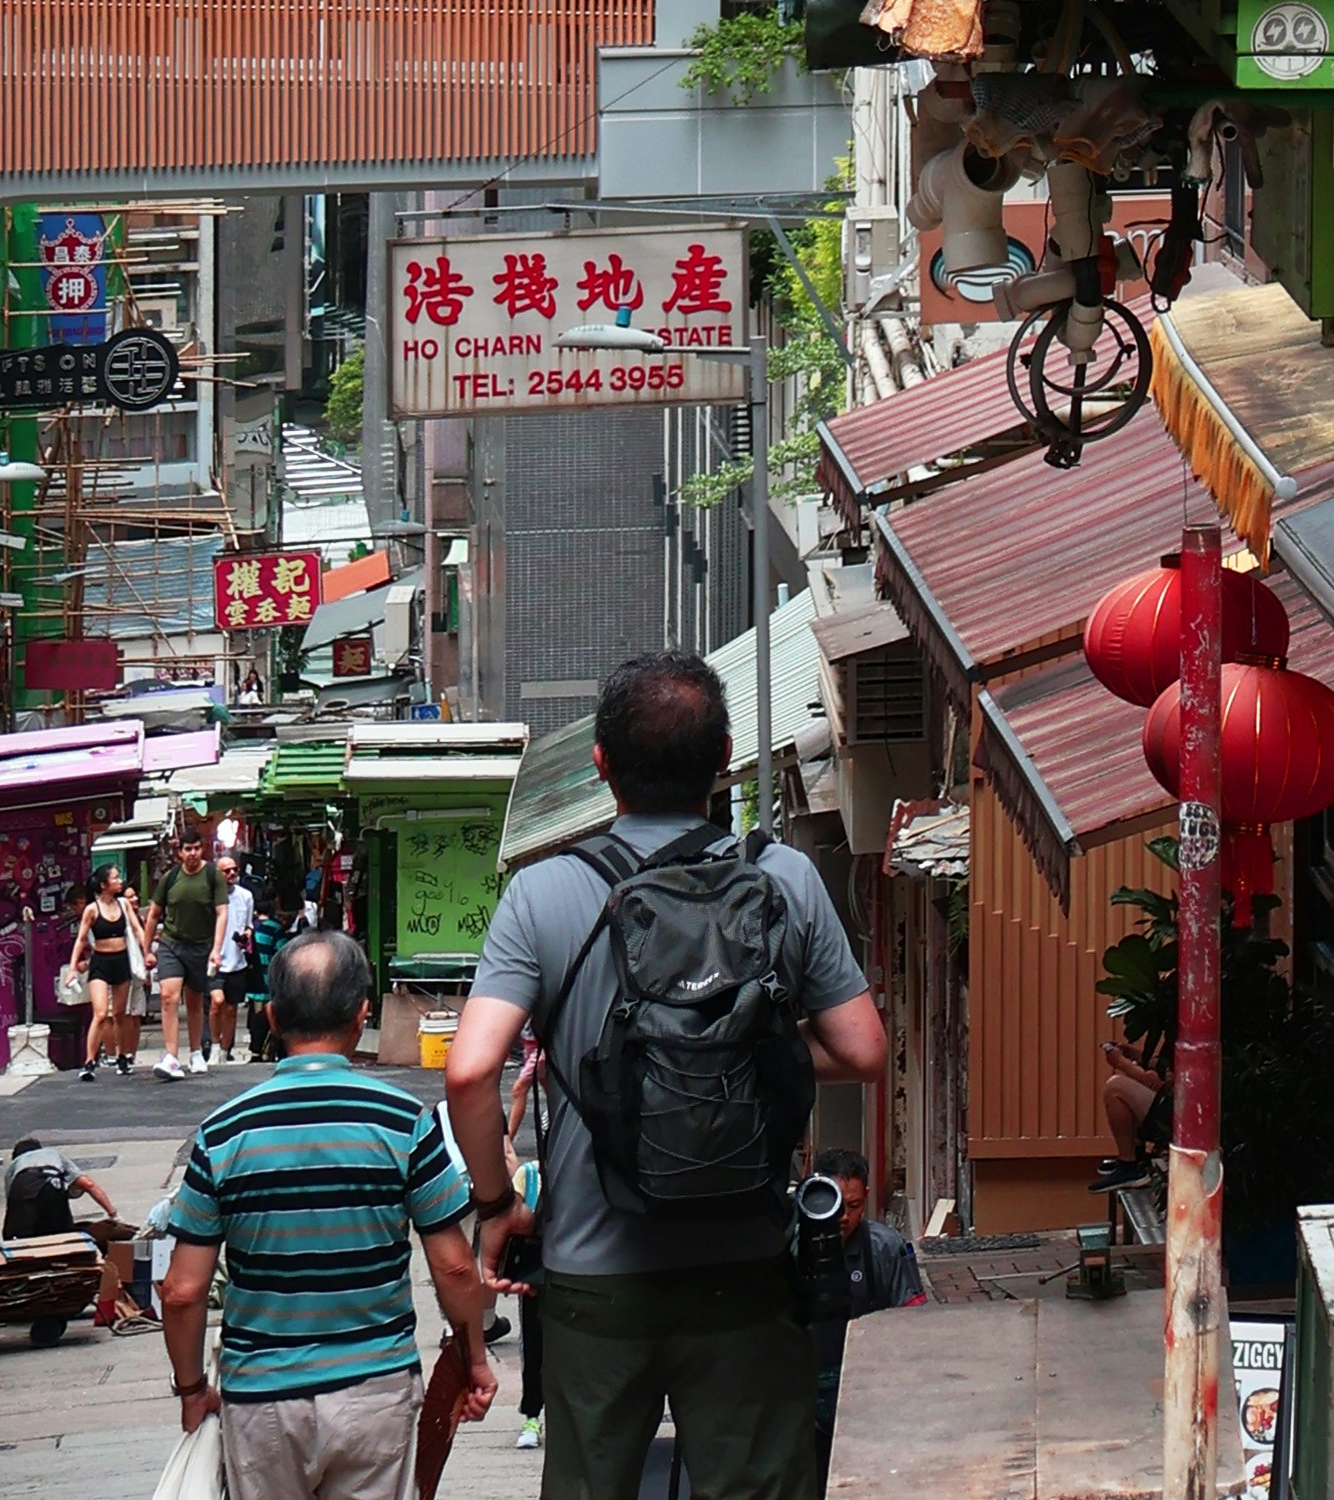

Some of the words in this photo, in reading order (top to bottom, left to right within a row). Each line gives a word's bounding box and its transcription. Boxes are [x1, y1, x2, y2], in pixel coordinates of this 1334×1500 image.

[58, 277, 86, 305] 押
[59, 352, 97, 371] ON
[403, 338, 439, 361] HO
[455, 334, 543, 359] CHARN
[453, 373, 515, 400] TEL:
[527, 369, 603, 397] 2544
[610, 364, 685, 392] 3955
[225, 557, 311, 600] 權記
[224, 593, 313, 627] 雲吞麵
